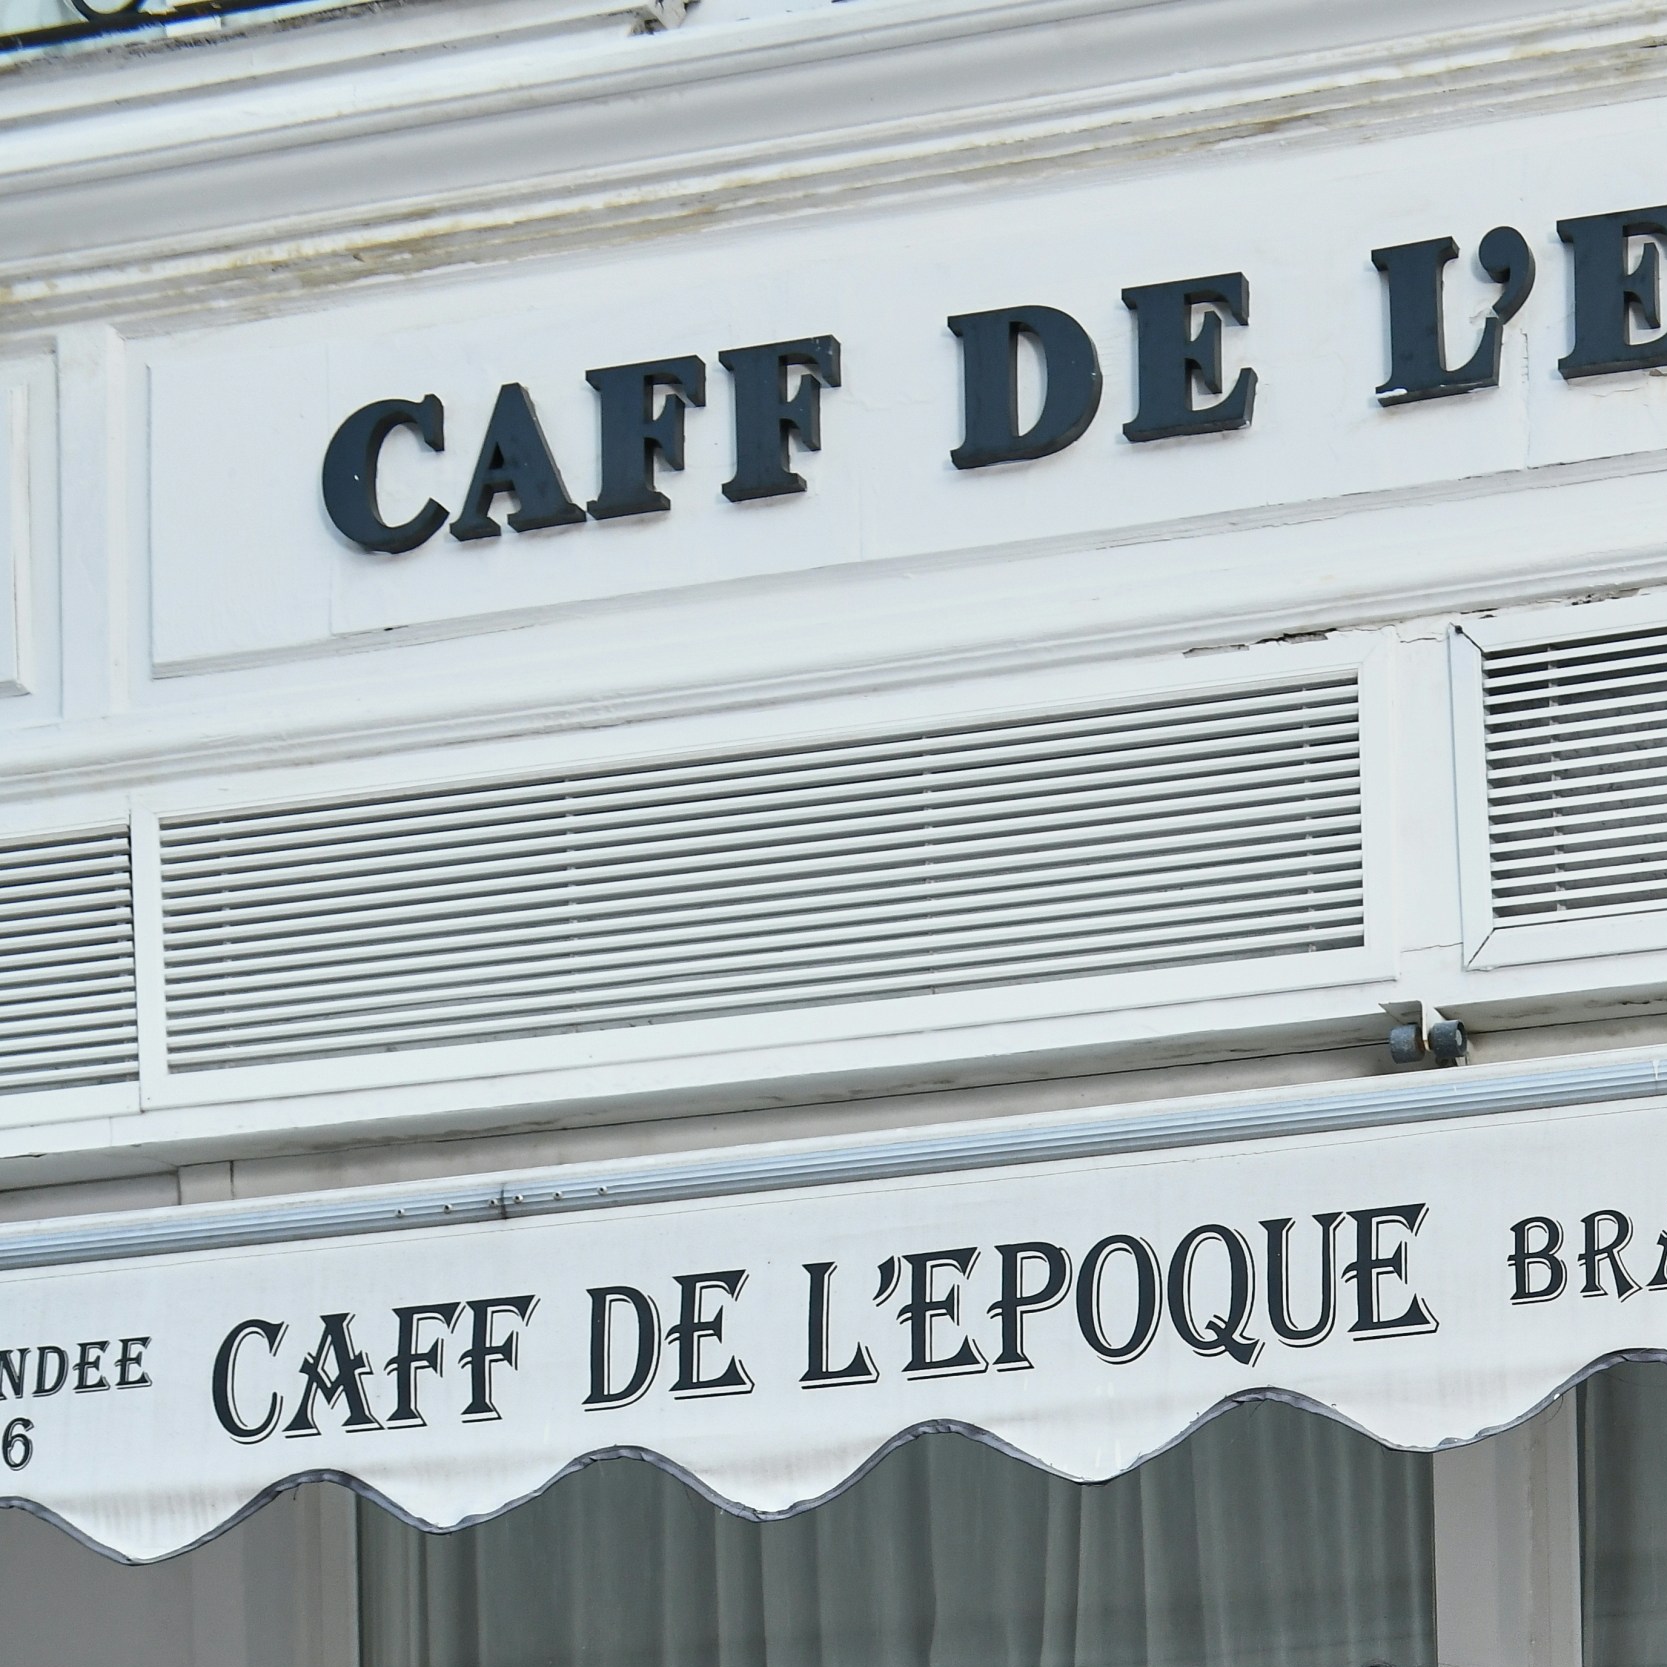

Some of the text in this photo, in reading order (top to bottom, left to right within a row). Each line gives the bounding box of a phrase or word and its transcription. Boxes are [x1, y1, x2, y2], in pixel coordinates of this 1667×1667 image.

[322, 335, 841, 555] CAFF
[948, 272, 1258, 470] DE
[212, 1295, 540, 1444] CAFF
[582, 1269, 755, 1411] DE
[799, 1203, 1439, 1389] L'EPOQUE
